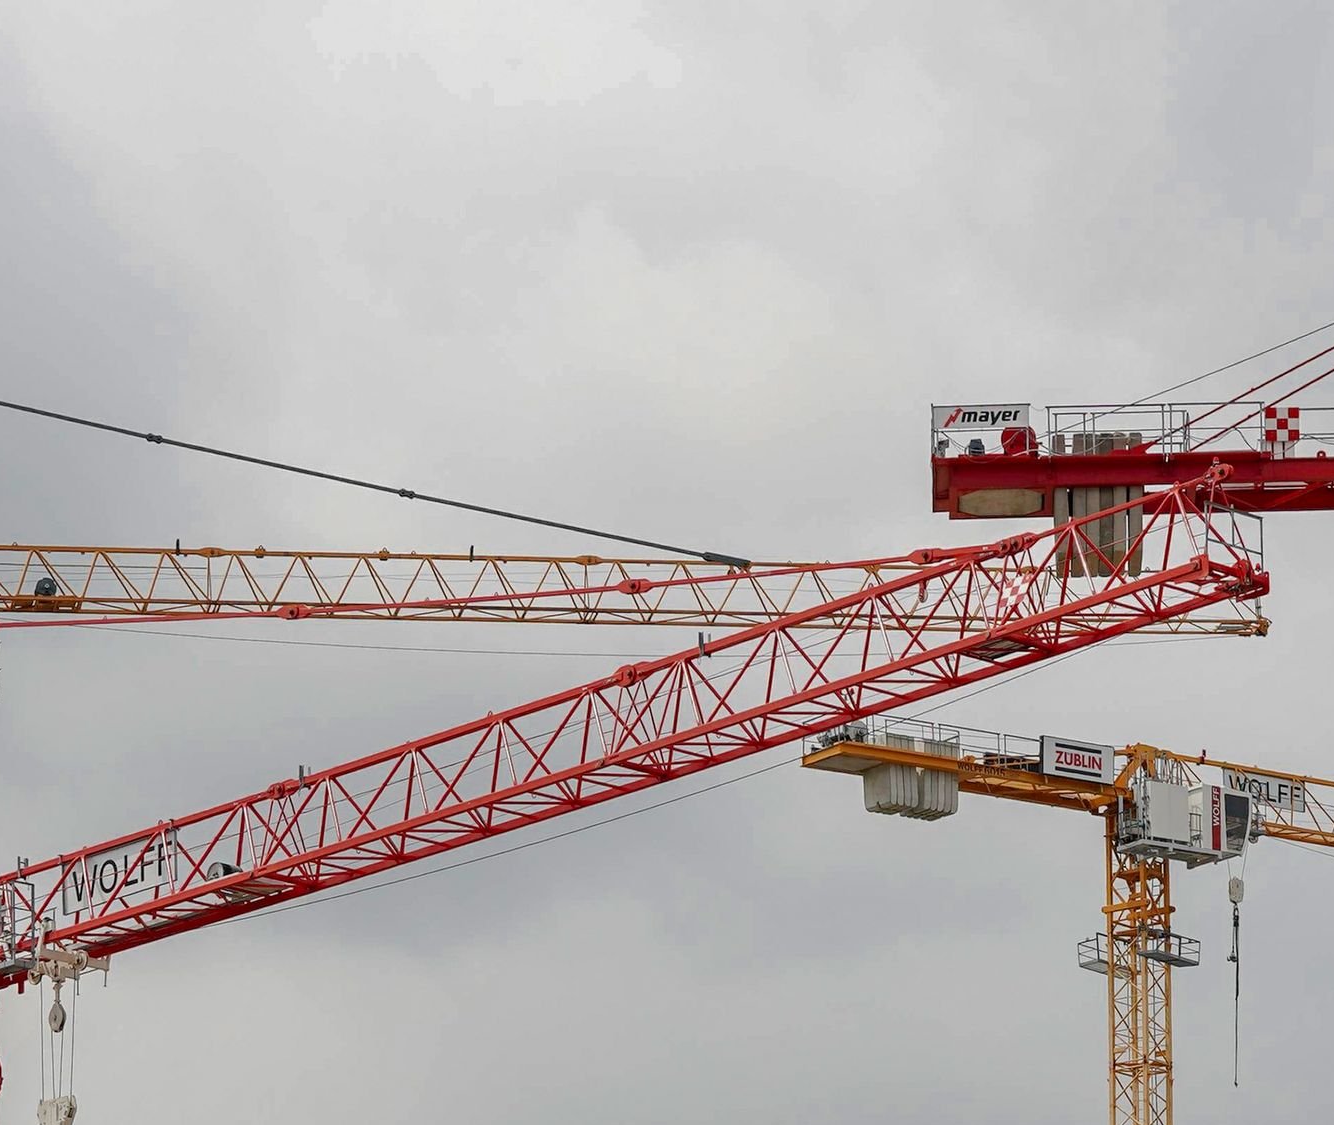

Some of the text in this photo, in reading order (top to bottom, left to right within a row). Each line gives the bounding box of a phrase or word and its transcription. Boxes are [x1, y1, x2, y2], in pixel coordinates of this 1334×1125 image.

[961, 409, 1021, 425] mayer
[1212, 787, 1221, 826] WOLFF
[72, 840, 173, 902] WOLFF
